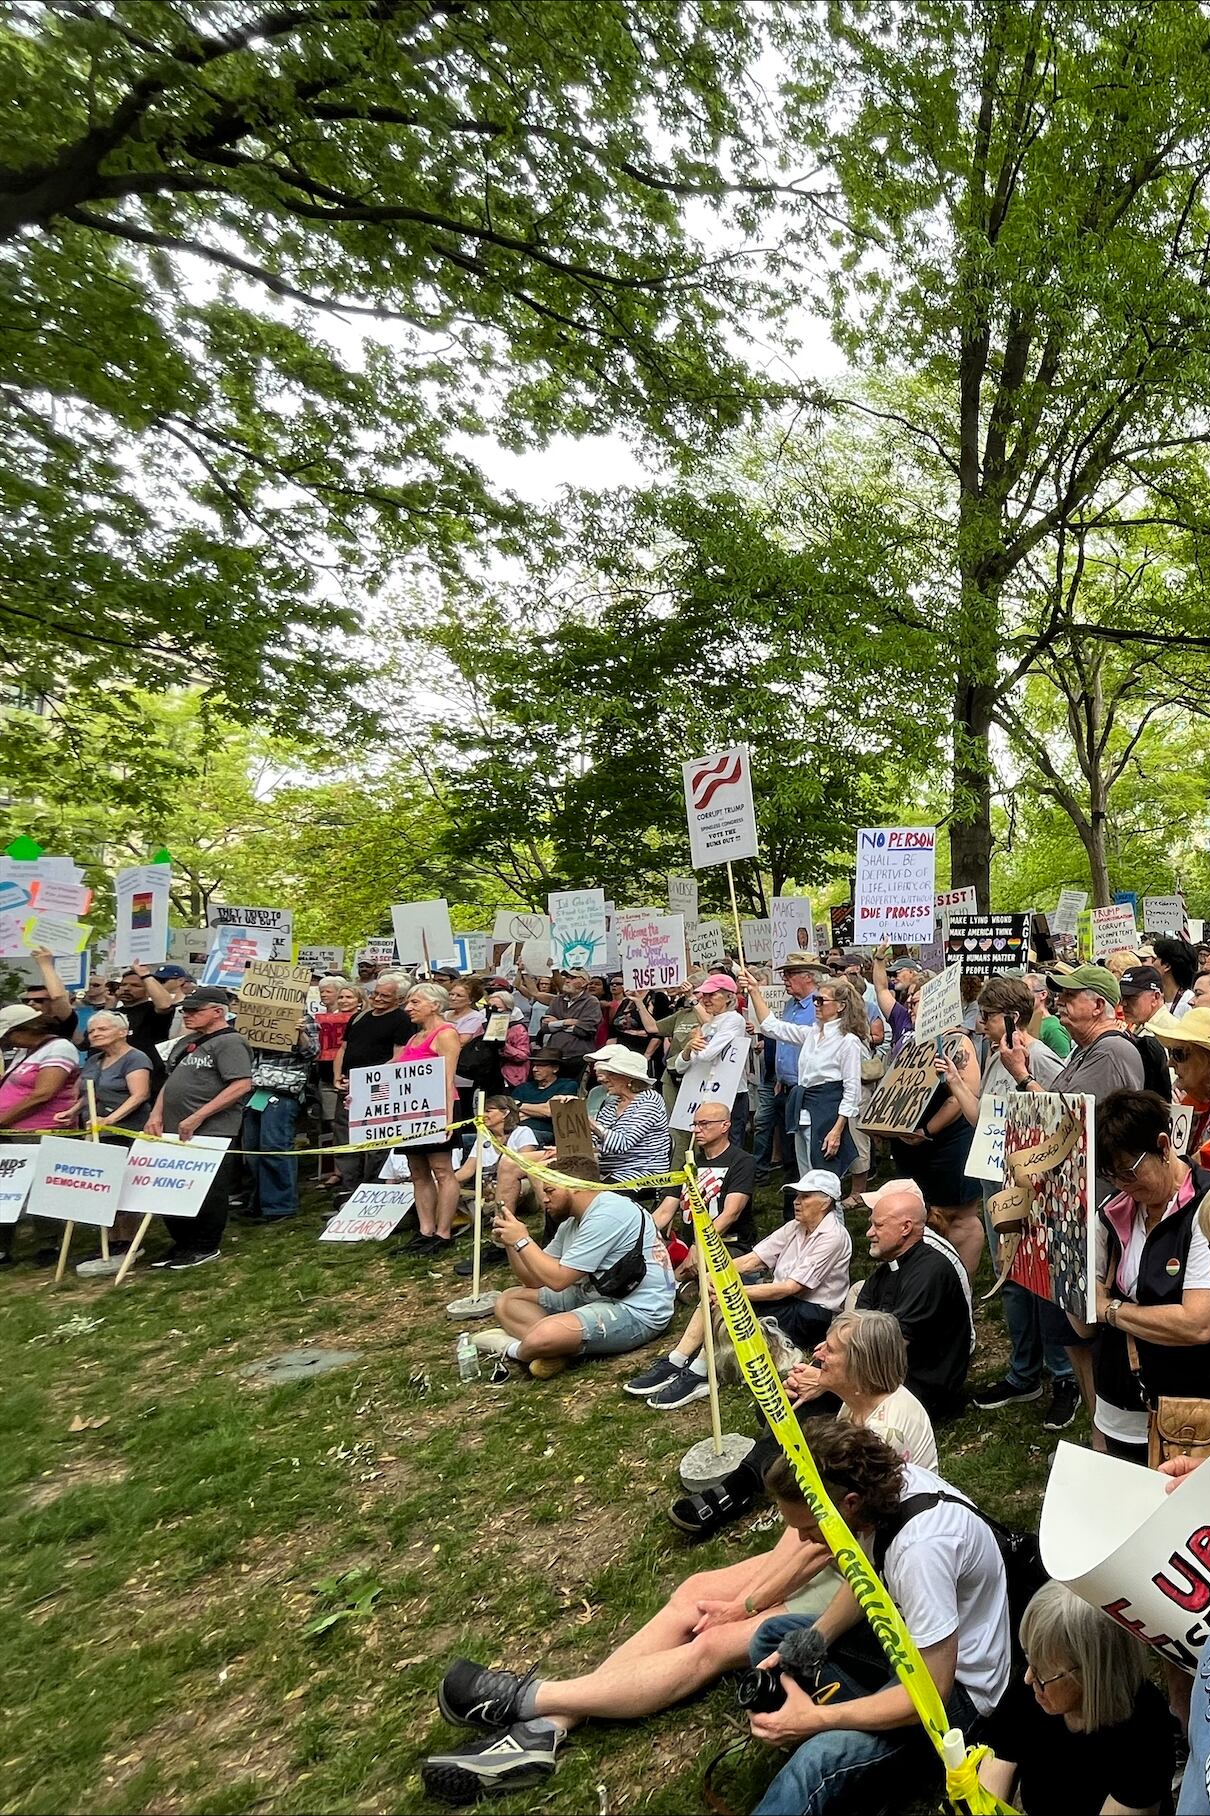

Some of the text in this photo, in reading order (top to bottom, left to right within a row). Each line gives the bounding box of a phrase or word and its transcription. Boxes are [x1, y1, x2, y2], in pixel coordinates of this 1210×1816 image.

[697, 803, 744, 820] CORRUPT TRUMP
[709, 831, 723, 839] VOTE
[861, 832, 934, 849] NO PERSON
[862, 853, 917, 866] SHALL BE
[862, 867, 929, 880] DEPRIVED OF
[934, 889, 974, 907] SIST!
[216, 907, 281, 919] THEY TRIED TO
[773, 901, 795, 917] MAKE
[860, 907, 881, 919] DUE
[886, 905, 931, 919] PROCESS
[1093, 907, 1120, 918] TRUMP
[245, 916, 277, 926] US BUT
[949, 916, 1012, 924] MAKE LYING WRONG
[1098, 921, 1126, 931] CORRUPT
[773, 922, 788, 938] ASS
[880, 932, 932, 942] AMENDMENT
[949, 928, 1013, 936] MAKE AMERICA THINK
[1096, 929, 1133, 940] INCOMPETENT
[773, 942, 785, 959] GO
[947, 953, 1016, 962] MAKE HUMANS MATTER
[253, 962, 311, 983] HANDS OFF
[633, 965, 679, 989] RISE UP!
[966, 966, 989, 974] PEOPLE
[242, 983, 307, 1003] CONSTITUTION
[239, 1003, 294, 1018] HANDS OFF
[252, 1016, 279, 1030] DUE
[239, 1026, 293, 1046] PROCESS
[894, 1038, 957, 1069] CHECS
[366, 1063, 433, 1084] NO KINGS
[895, 1070, 926, 1086] AND
[399, 1083, 411, 1096] IN
[365, 1098, 430, 1118] AMERICA
[861, 1086, 933, 1129] BALANCES
[366, 1124, 401, 1140] SINCE
[411, 1121, 437, 1134] 1776
[556, 1111, 588, 1140] CAN
[54, 1163, 104, 1178] PROTECT
[128, 1156, 217, 1173] NOLIGARCHY!
[45, 1176, 111, 1193] DEMOCRACY!
[132, 1176, 150, 1186] NO
[358, 1205, 385, 1217] NOT
[328, 1219, 396, 1237] OLIGARCHY
[702, 1222, 731, 1273] CAUTION
[722, 1281, 757, 1342] CAUTION
[745, 1352, 788, 1424] CAUTION
